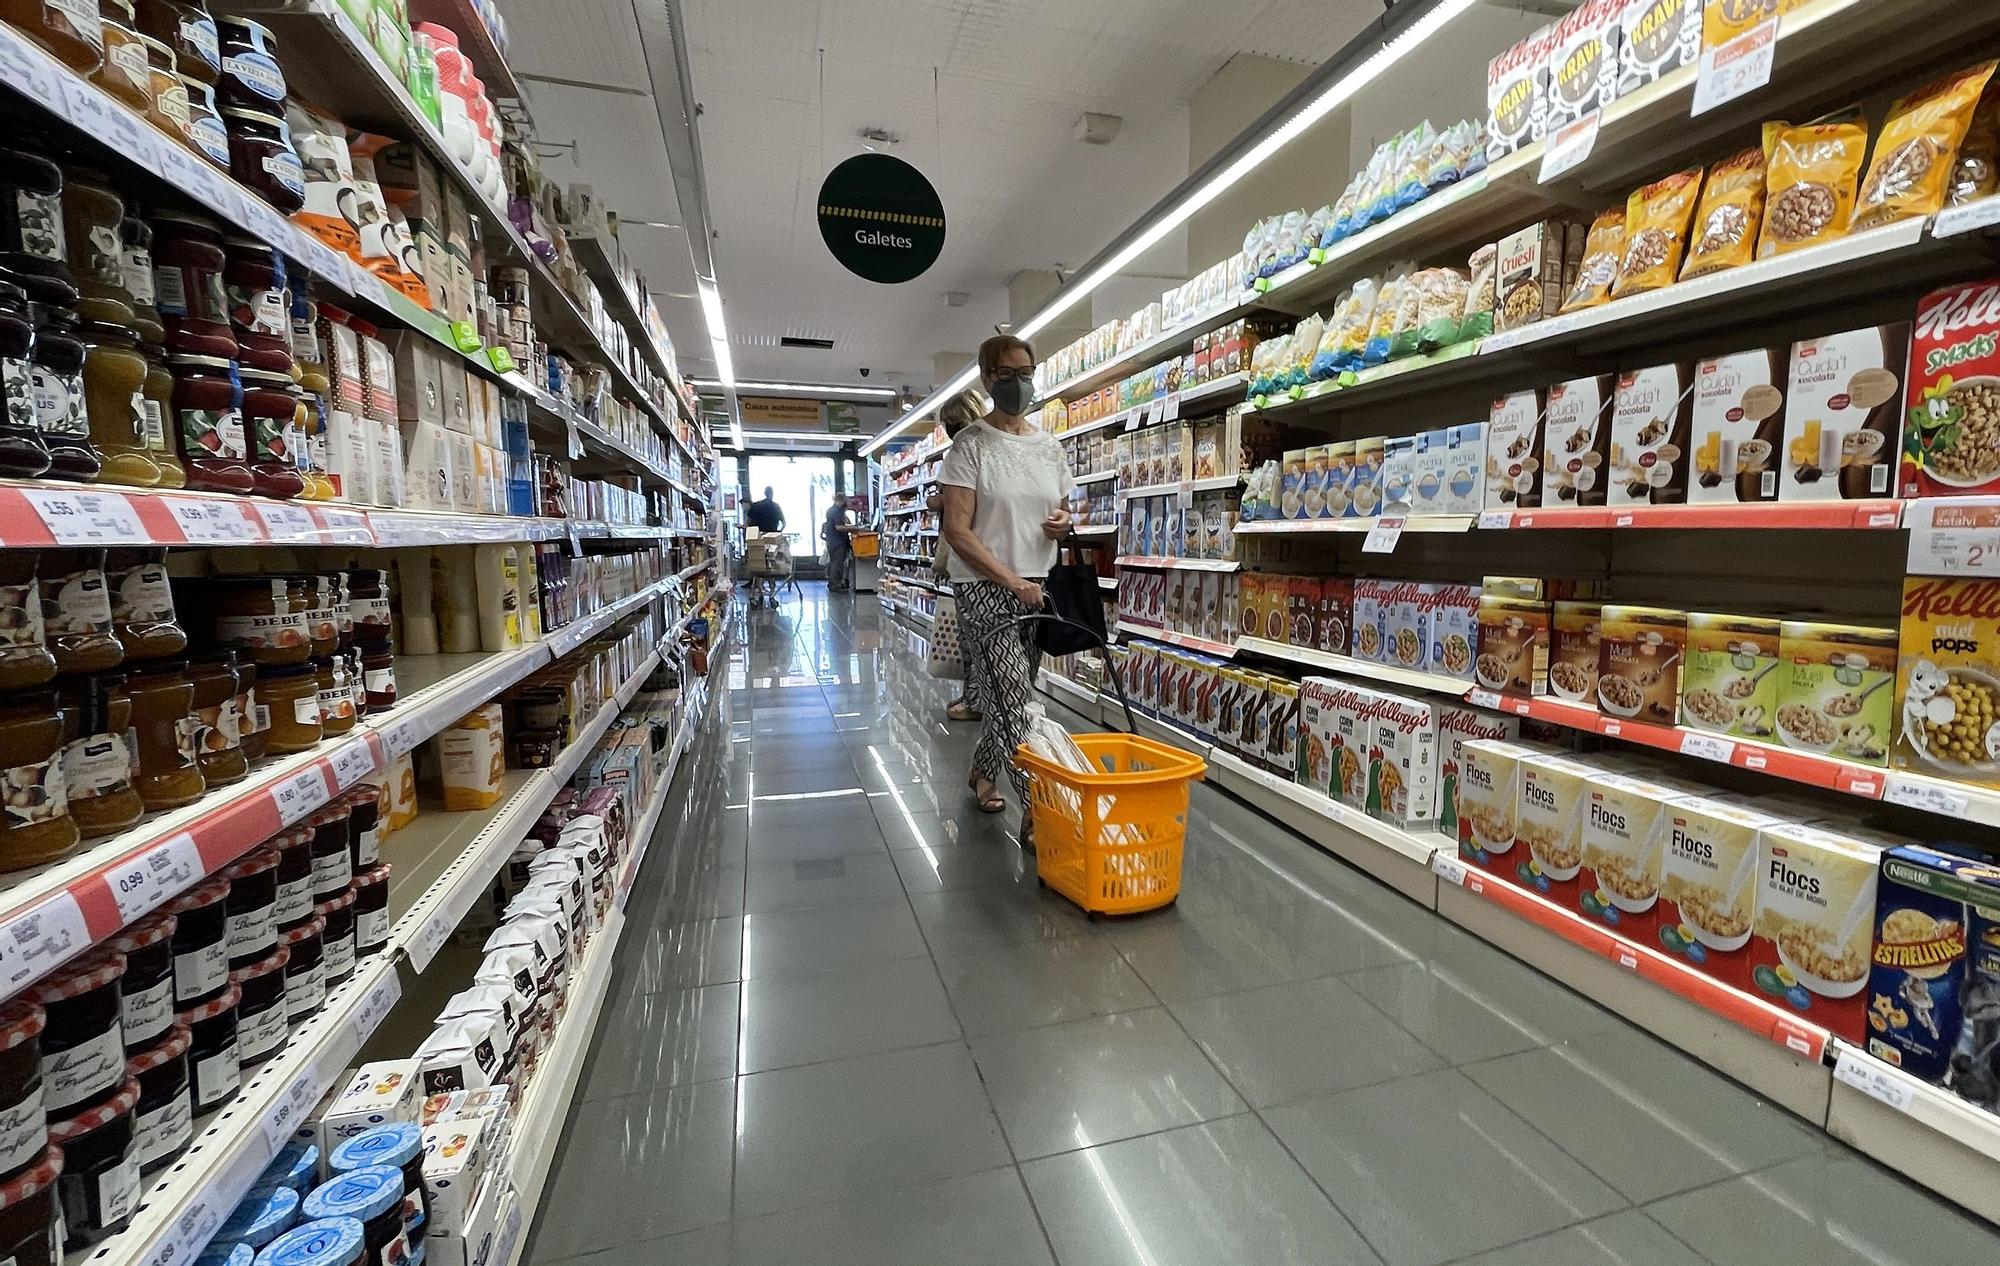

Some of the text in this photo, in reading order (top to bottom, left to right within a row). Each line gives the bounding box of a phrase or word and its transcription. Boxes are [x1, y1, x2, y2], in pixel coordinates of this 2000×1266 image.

[855, 229, 912, 249] Galetes
[1501, 244, 1536, 274] Cruesli
[1924, 329, 1999, 376] Smacks
[1797, 372, 1836, 385] xocolata
[1618, 406, 1651, 416] xocolata
[1935, 515, 1977, 527] estalvi
[1931, 637, 1978, 655] pops
[1379, 727, 1396, 741] CORN
[1466, 763, 1492, 784] Flocs
[1525, 781, 1555, 805] Flocs
[1591, 803, 1626, 830] Flocs
[1672, 829, 1713, 859] Flocs
[119, 871, 144, 894] 0,99
[1770, 859, 1820, 894] Flocs
[1874, 937, 1964, 966] ESTRELLITAS
